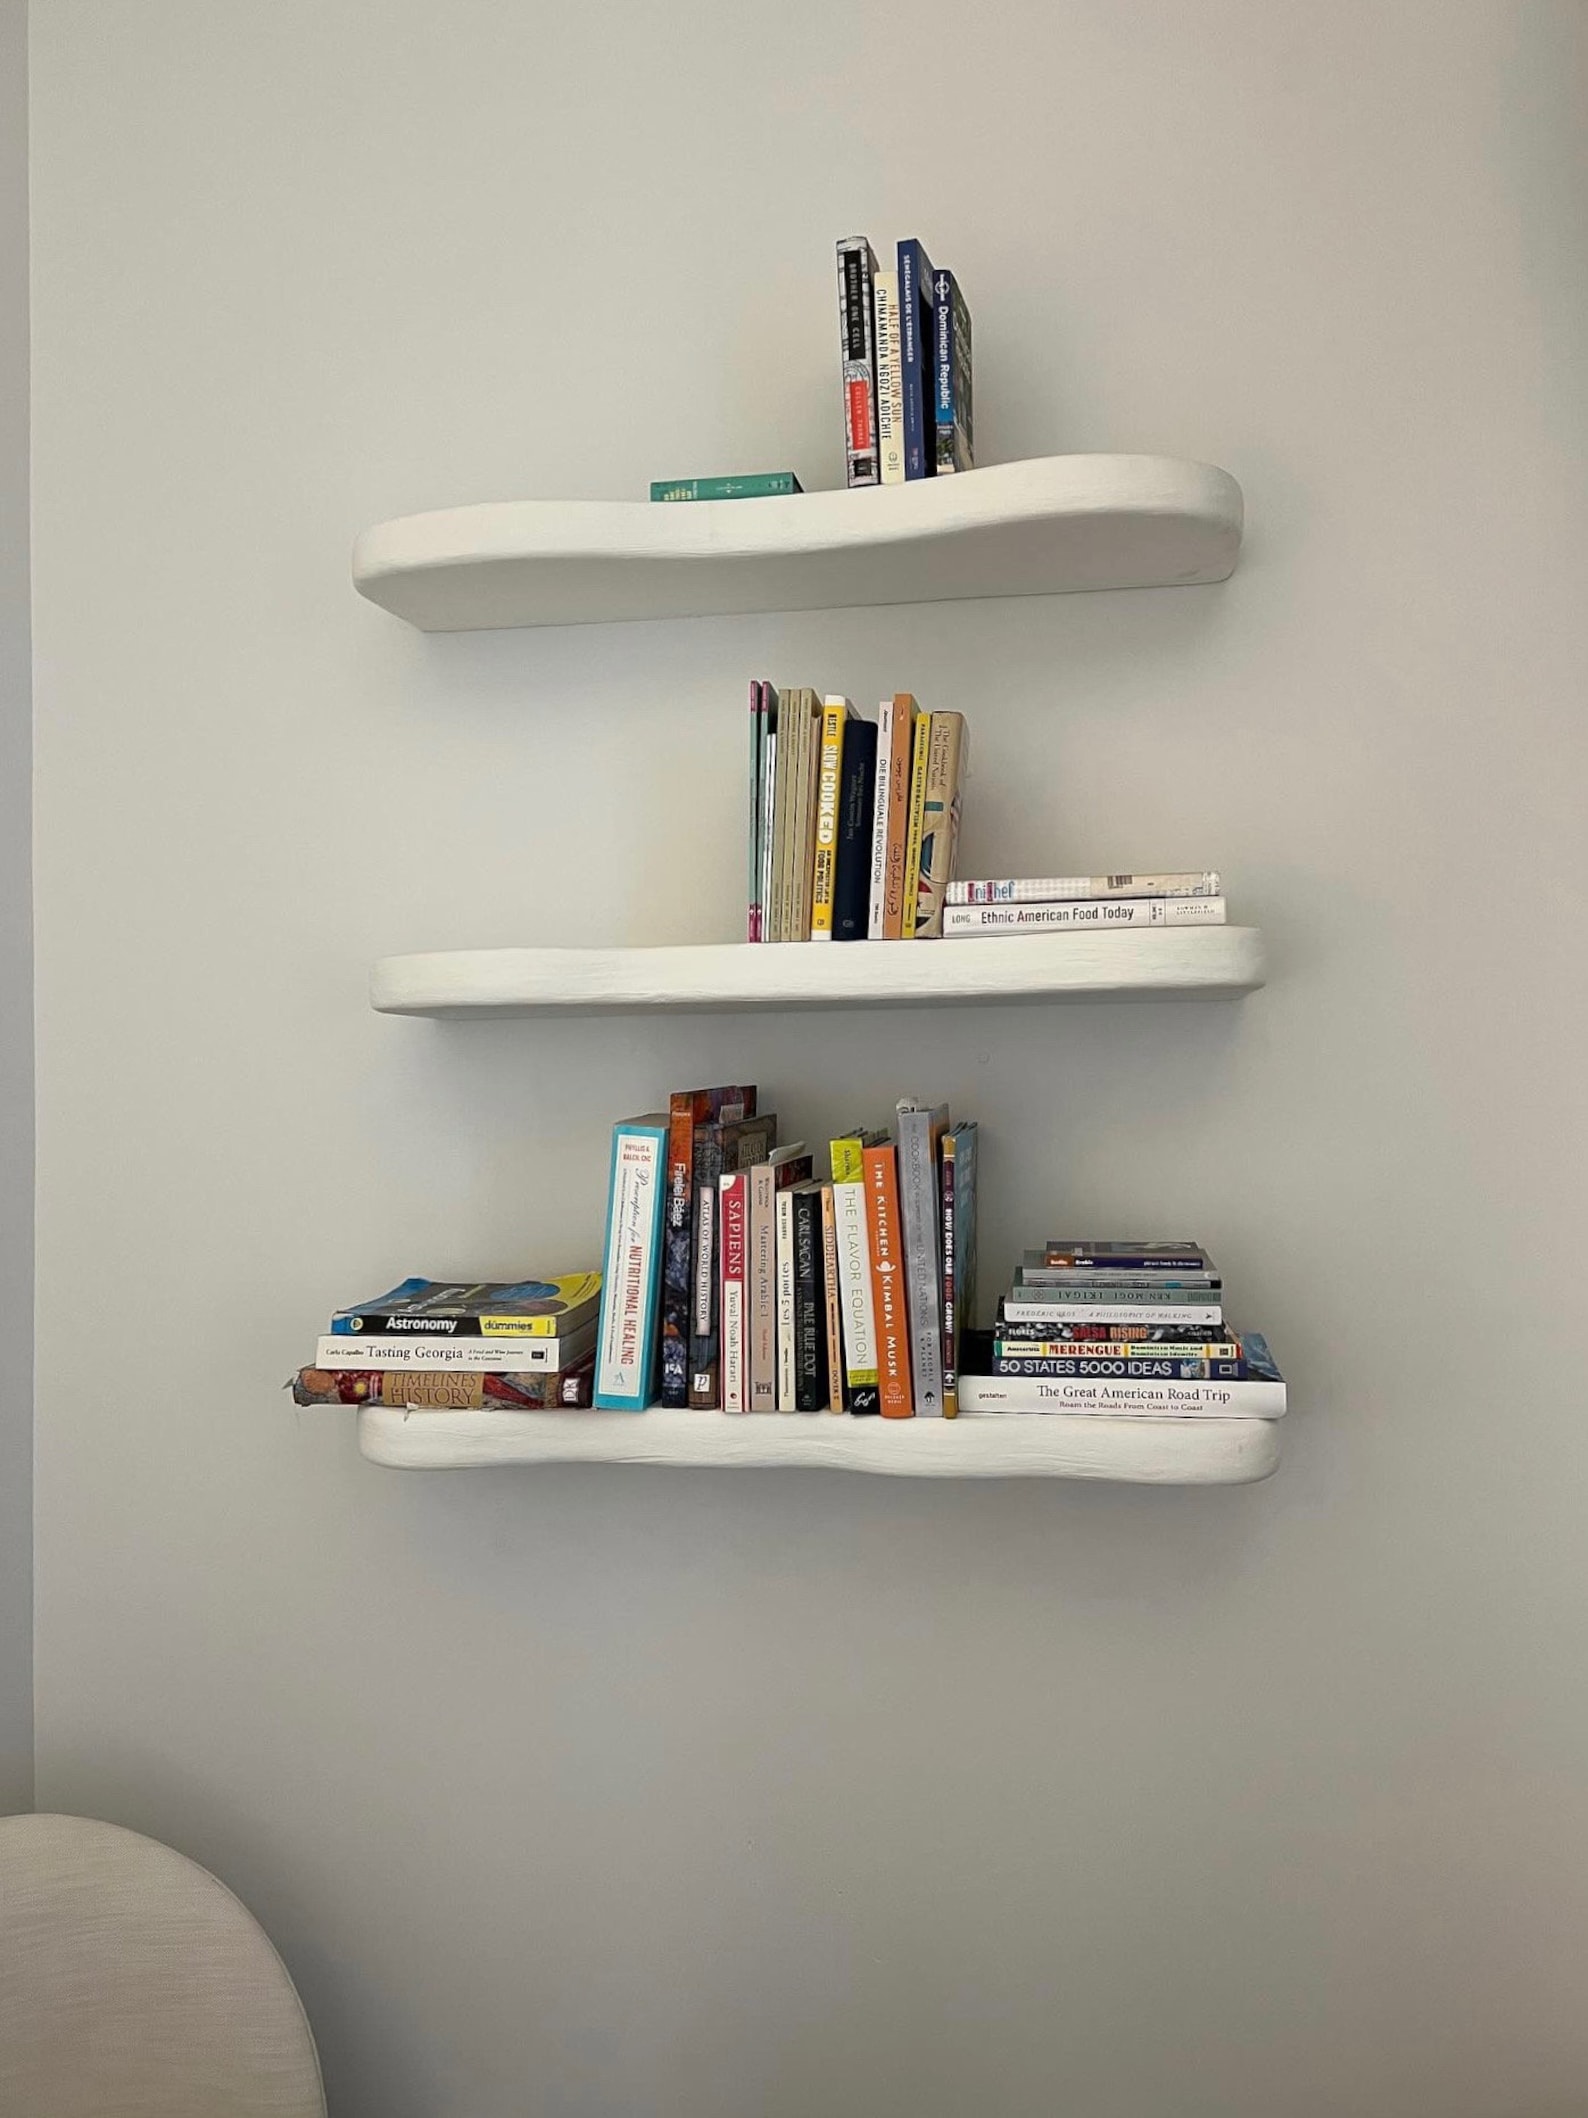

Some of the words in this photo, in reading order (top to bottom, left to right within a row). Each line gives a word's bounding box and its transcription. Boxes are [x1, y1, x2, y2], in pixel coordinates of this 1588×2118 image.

[888, 304, 899, 329] HALF
[905, 303, 912, 314] DE
[876, 289, 888, 359] CHIMAMANDA
[937, 306, 950, 361] Dominican
[889, 333, 899, 344] OF
[879, 364, 890, 395] NGOZI
[890, 358, 902, 399] YELLOW
[937, 364, 951, 409] Republic
[881, 399, 892, 440] ADICHIE
[891, 402, 902, 423] SUN
[823, 745, 838, 769] SLOW
[879, 759, 887, 773] DIE
[818, 771, 837, 844] COOKED
[877, 776, 887, 826] BILINGUALE
[818, 850, 826, 869] FOOD
[874, 829, 884, 884] REVOLUTION
[816, 870, 825, 904] POLITICS
[951, 913, 971, 924] LONG
[981, 907, 1014, 924] Ethnic
[1017, 906, 1070, 922] American
[1072, 905, 1099, 920] Food
[1101, 904, 1134, 921] Today
[874, 1163, 883, 1188] THE
[911, 1136, 921, 1190] COOKBOOK
[673, 1162, 686, 1197] Firelei
[630, 1168, 649, 1227] Prescription
[845, 1189, 857, 1217] THE
[702, 1199, 710, 1226] ATLAS
[798, 1208, 811, 1237] CARL
[877, 1195, 889, 1256] KITCHEN
[945, 1208, 953, 1230] HOW
[628, 1227, 640, 1243] for
[702, 1229, 710, 1240] OF
[729, 1200, 742, 1275] SAPIENS
[945, 1232, 953, 1255] DOES
[701, 1244, 710, 1278] WORLD
[759, 1225, 769, 1274] Mastering
[798, 1238, 811, 1278] SAGAN
[825, 1225, 836, 1298] SIDDHARTHA
[847, 1224, 862, 1280] FLAVOR
[916, 1245, 926, 1281] UNITED
[782, 1261, 791, 1297] portes
[945, 1257, 953, 1275] OUR
[624, 1246, 643, 1316] NUTRITIONAL
[760, 1277, 769, 1310] Arabic
[945, 1276, 953, 1300] FOOD
[700, 1281, 709, 1322] HISTORY
[729, 1290, 739, 1317] Yuval
[882, 1275, 894, 1328] KIMBAL
[919, 1283, 929, 1327] NATIONS
[1057, 1291, 1103, 1300] IKIGAI
[1114, 1291, 1143, 1300] MOGI
[1147, 1291, 1171, 1300] KEN
[386, 1317, 458, 1334] Astronomy
[484, 1320, 533, 1330] dummies
[803, 1302, 816, 1325] PALE
[851, 1289, 868, 1364] EQUATION
[1096, 1310, 1143, 1318] PHILOSOPHY
[1157, 1311, 1193, 1319] WALKING
[621, 1320, 636, 1365] HEALING
[729, 1320, 739, 1347] Noah
[804, 1327, 816, 1352] BLUE
[1072, 1326, 1106, 1339] SALSA
[1109, 1326, 1148, 1339] RISING
[366, 1345, 411, 1361] Tasting
[415, 1346, 463, 1361] Georgia
[886, 1336, 898, 1376] MUSK
[1049, 1344, 1121, 1356] MERENGUE
[729, 1350, 739, 1383] Harari
[804, 1353, 816, 1378] DOT
[999, 1362, 1020, 1373] 50
[1023, 1361, 1076, 1374] STATES
[1079, 1361, 1125, 1374] 5000
[1127, 1361, 1172, 1375] IDEAS
[391, 1373, 477, 1387] TIMELINES
[563, 1378, 580, 1402] DK
[391, 1388, 474, 1405] HISTORY
[1036, 1385, 1060, 1397] The
[1063, 1385, 1097, 1398] Great
[1101, 1386, 1163, 1399] American
[1168, 1388, 1200, 1400] Road
[1202, 1389, 1231, 1404] Trip
[1147, 1402, 1169, 1410] Coast
[1180, 1403, 1203, 1411] Coast
